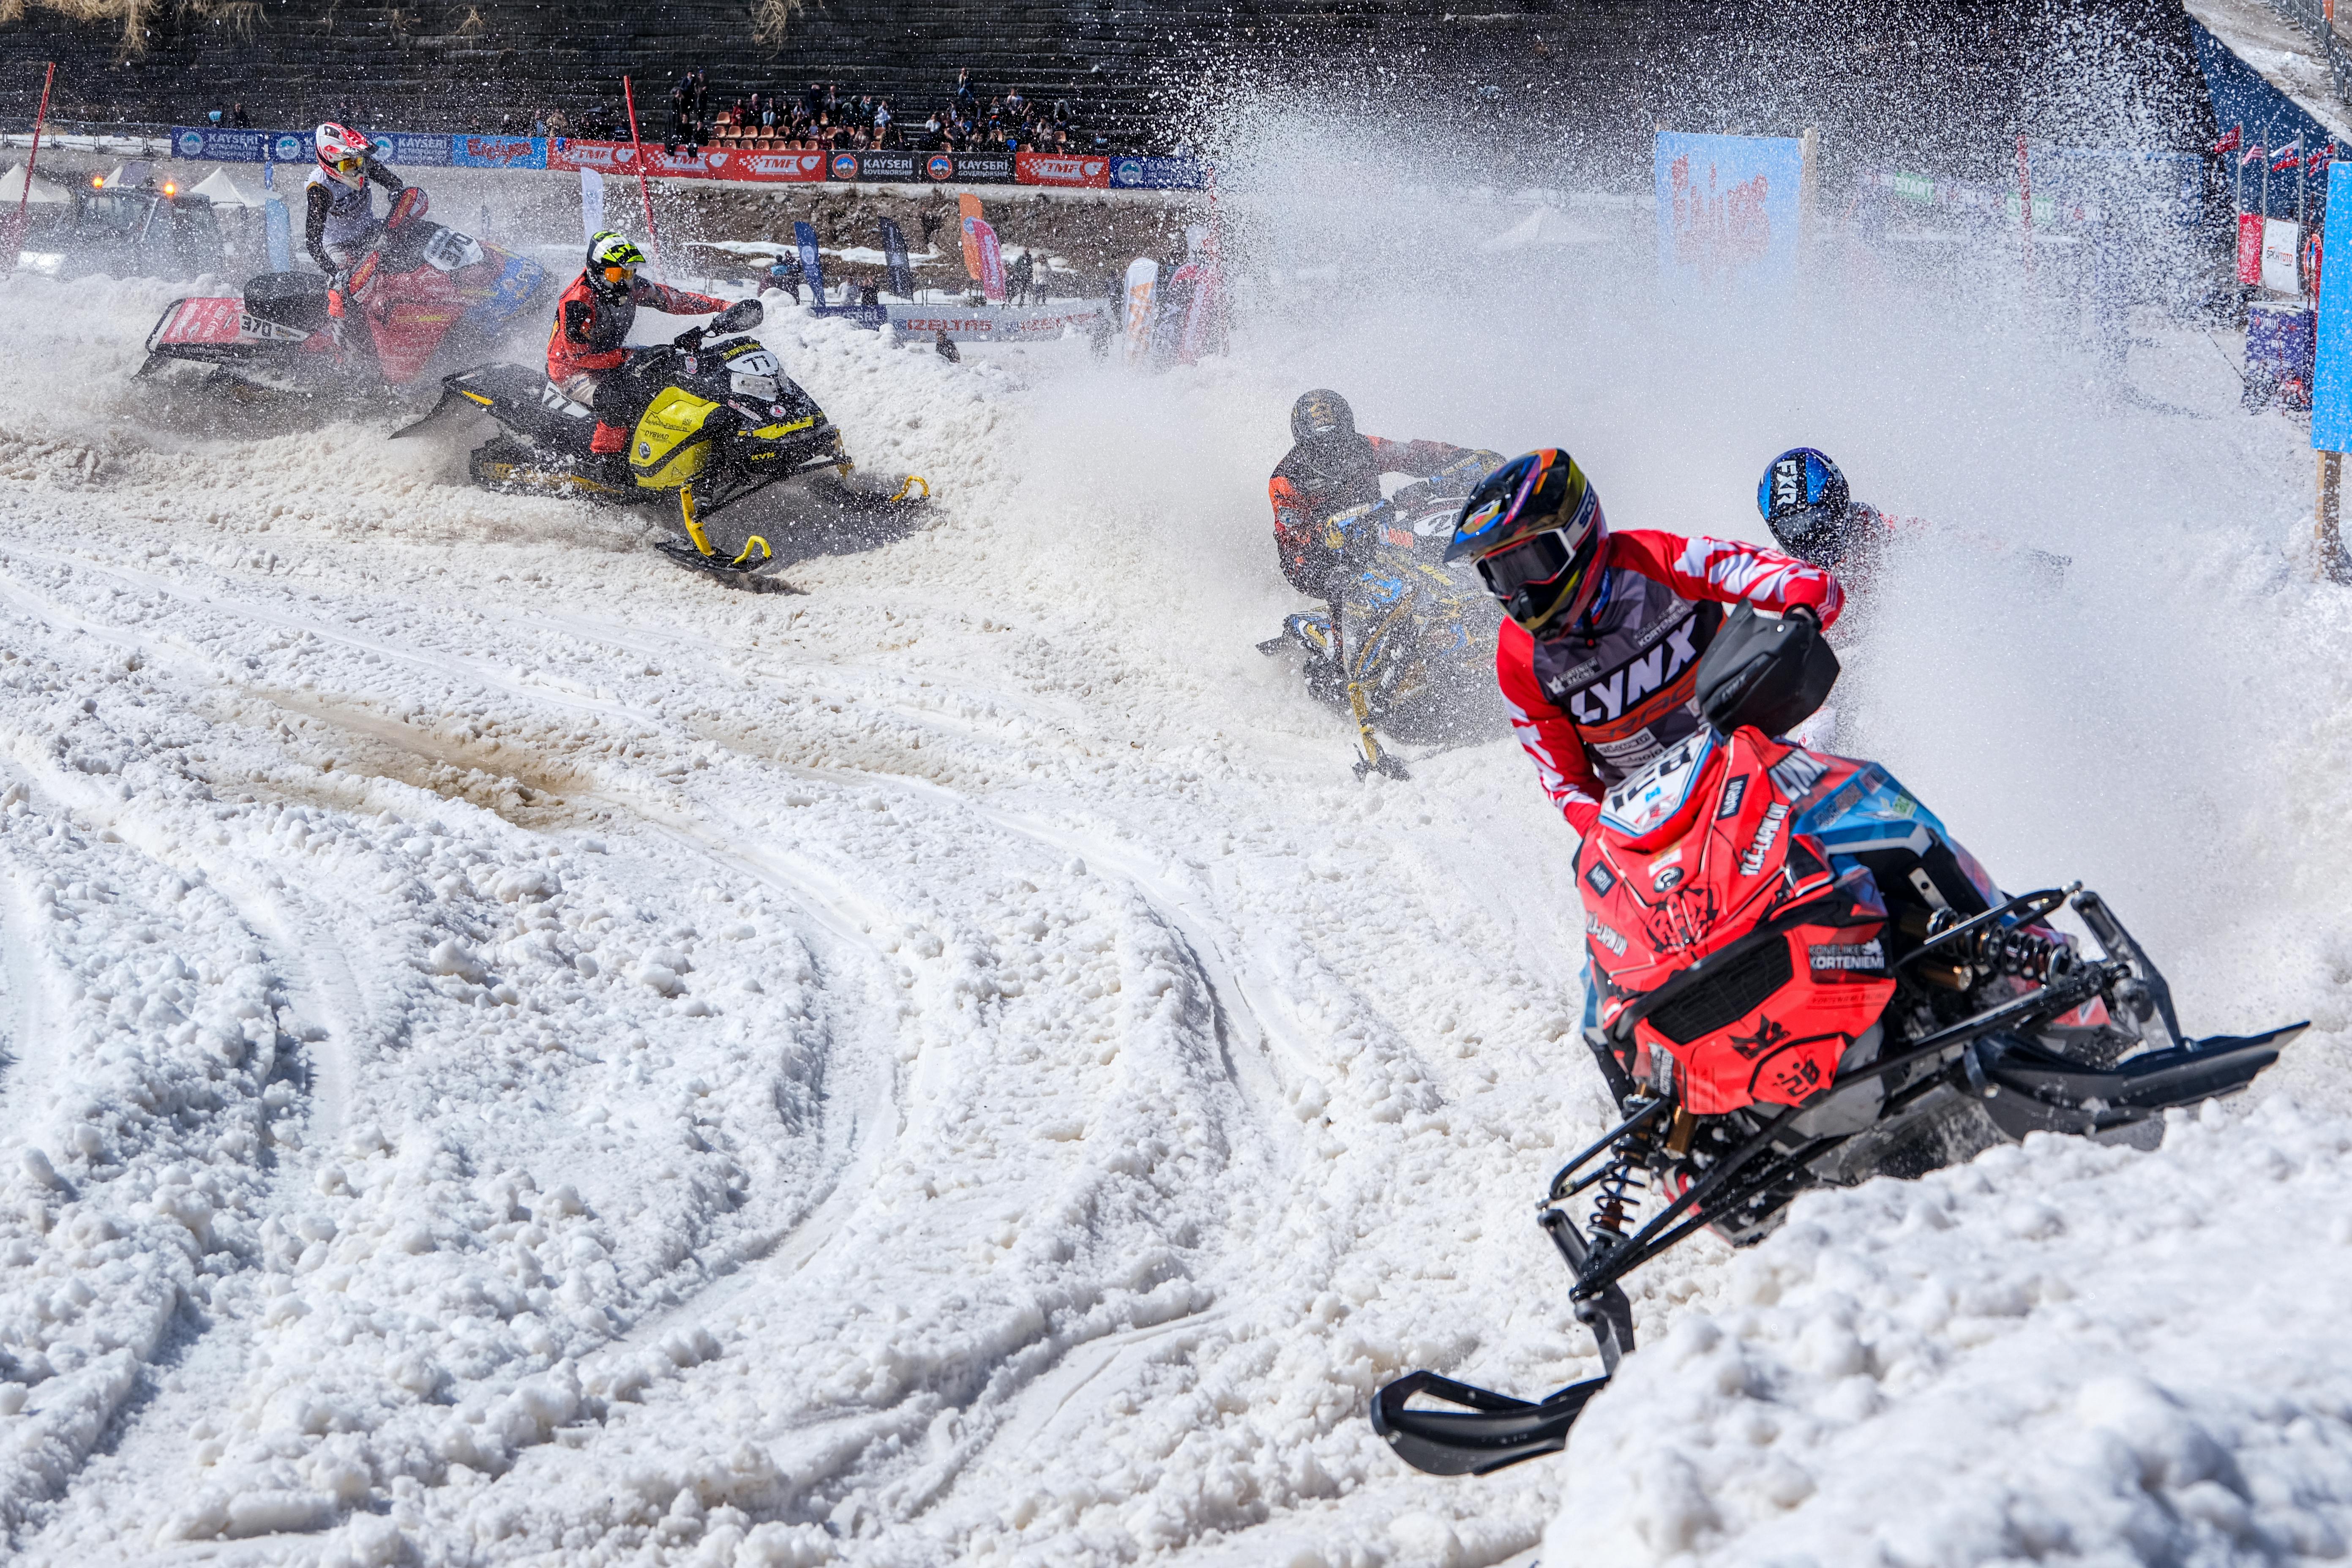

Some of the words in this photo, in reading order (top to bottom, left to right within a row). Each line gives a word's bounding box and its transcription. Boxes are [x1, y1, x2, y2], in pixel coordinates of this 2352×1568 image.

[578, 148, 609, 159] TMF
[672, 155, 703, 165] TMF
[763, 158, 796, 168] TMF
[863, 158, 913, 169] KAYSERİ
[1048, 163, 1080, 174] TMF
[1895, 177, 1934, 197] START
[439, 232, 474, 267] 370
[241, 314, 273, 338] 370
[742, 354, 772, 373] 77
[544, 386, 571, 413] 77
[644, 430, 670, 440] DYBVAD
[1776, 460, 1798, 506] FXR
[1571, 615, 1697, 724] LYNX
[1769, 749, 1831, 802] LYNX
[1810, 955, 1884, 969] KORTENIEMI
